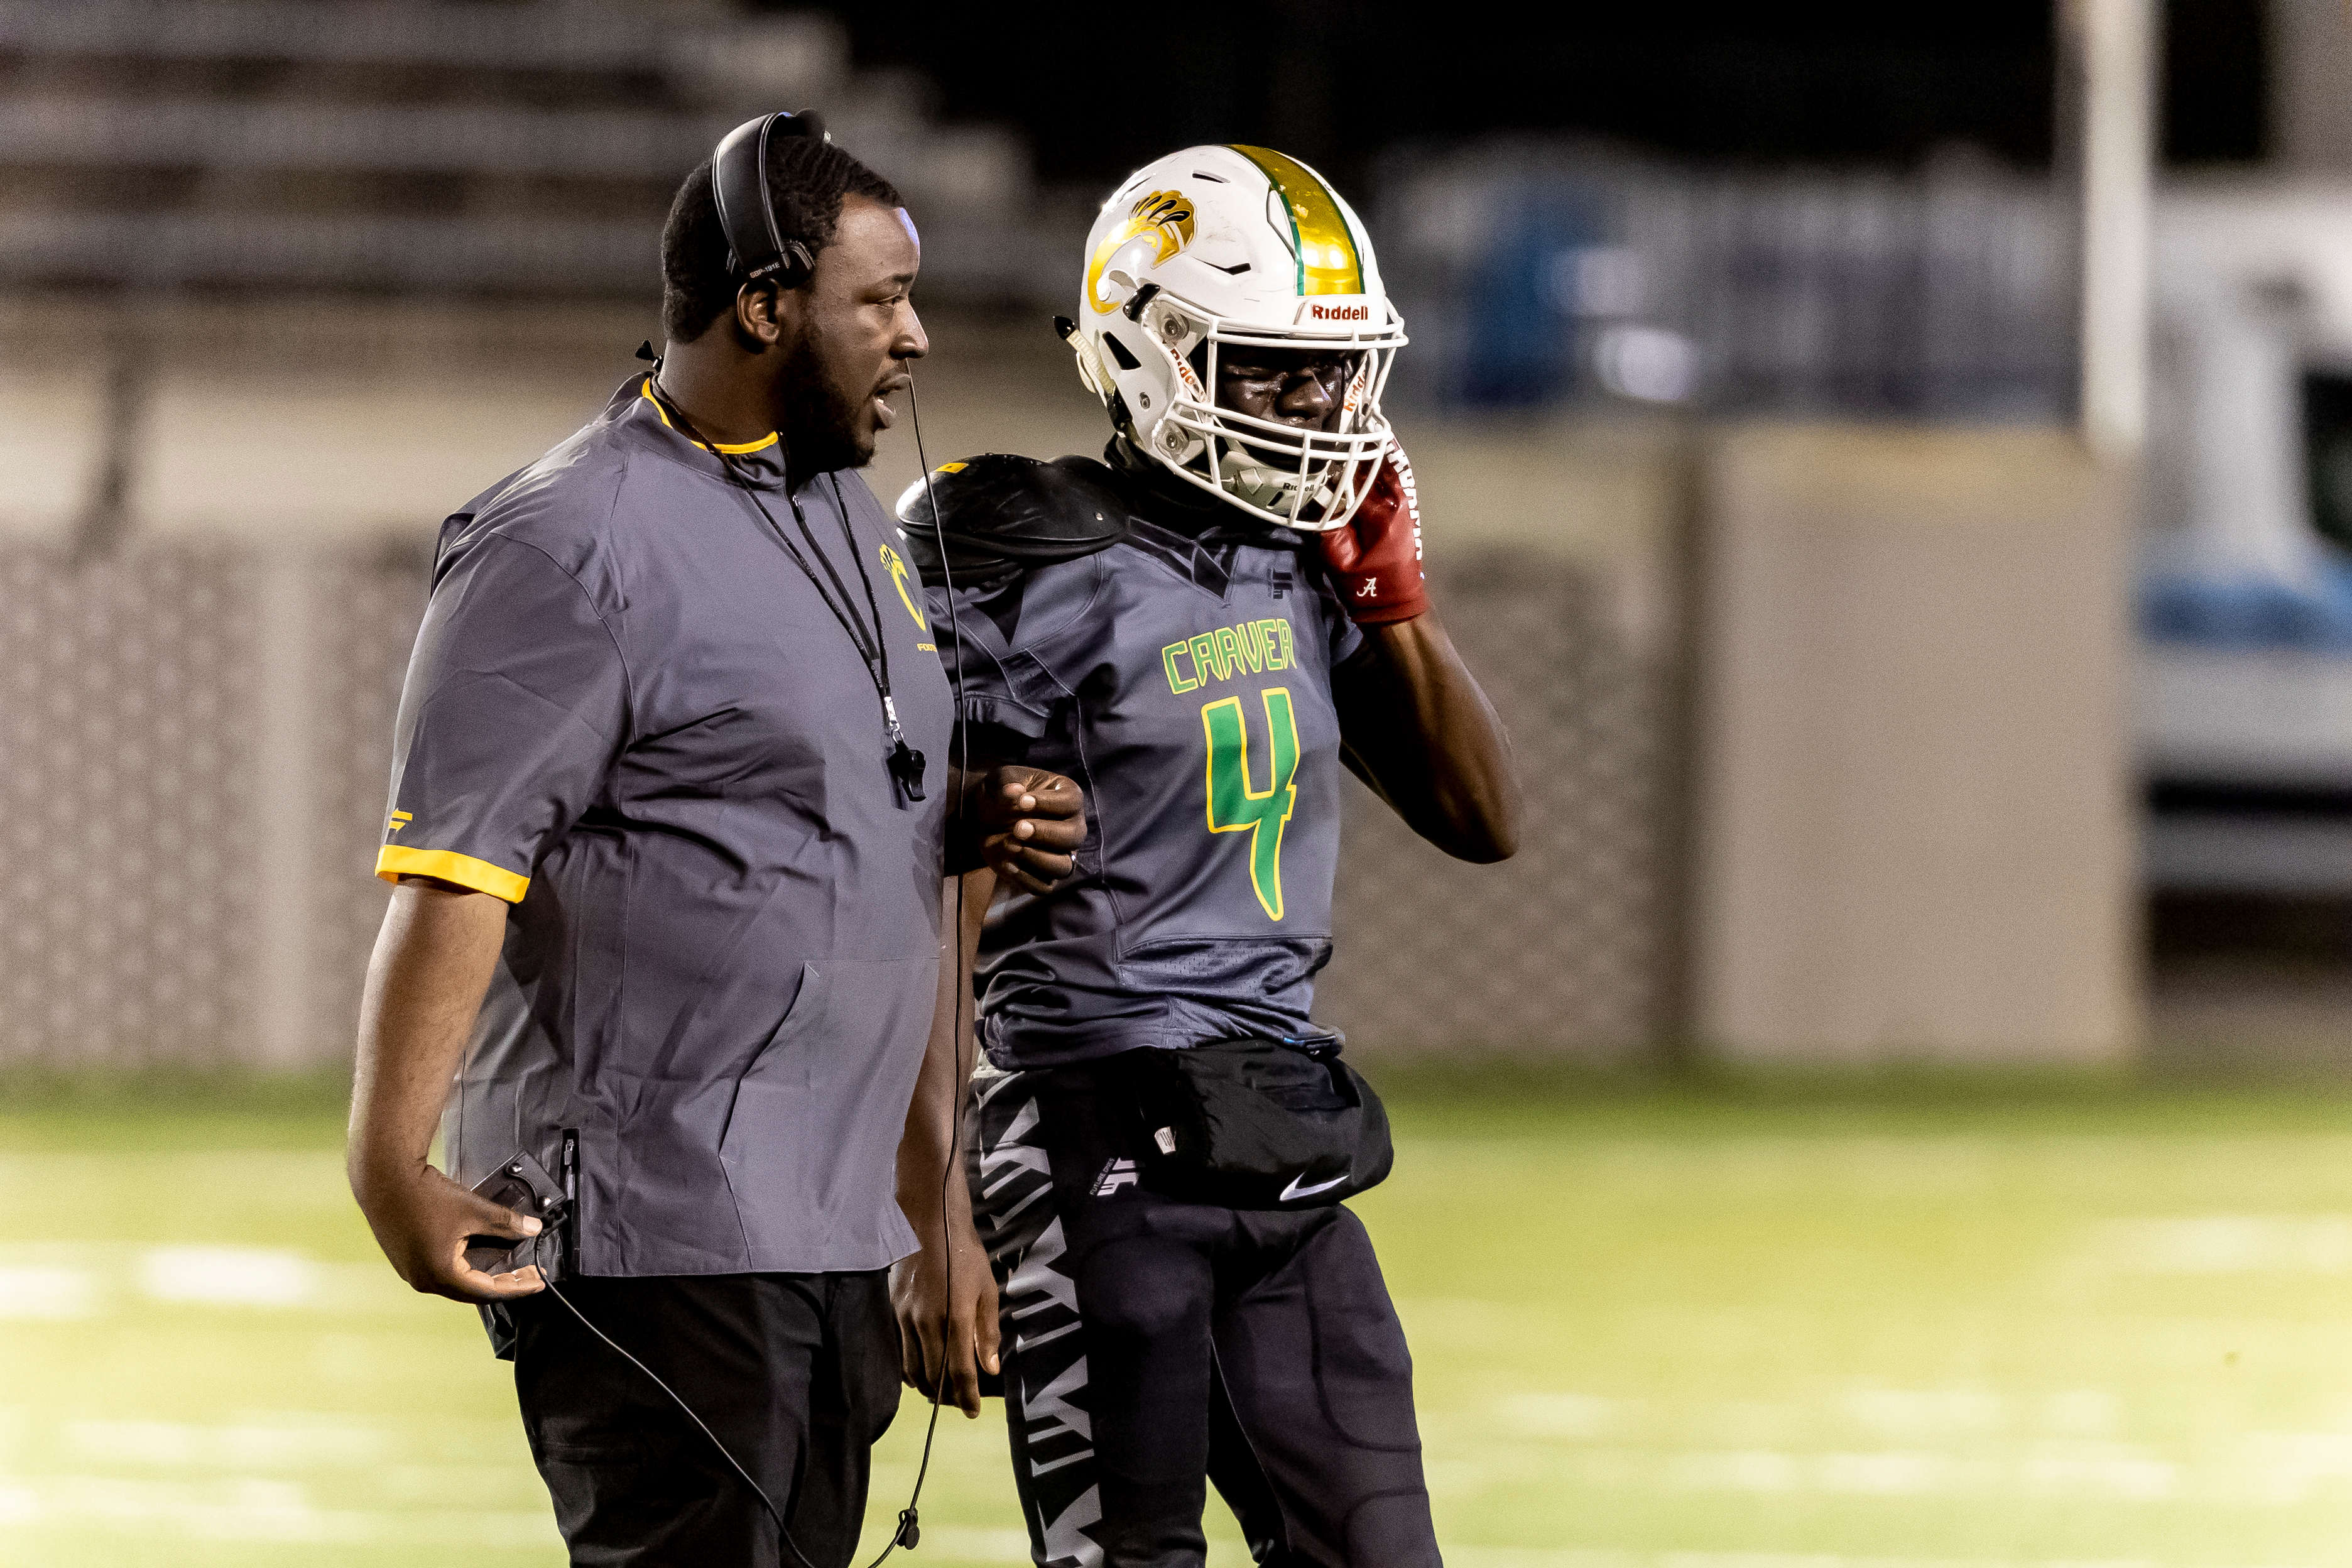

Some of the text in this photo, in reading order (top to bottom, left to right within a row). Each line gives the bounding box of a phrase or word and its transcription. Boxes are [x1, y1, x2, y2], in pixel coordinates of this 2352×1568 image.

[1312, 304, 1368, 320] Riddell
[1162, 618, 1297, 695] CARVER
[1200, 687, 1300, 922] 4
